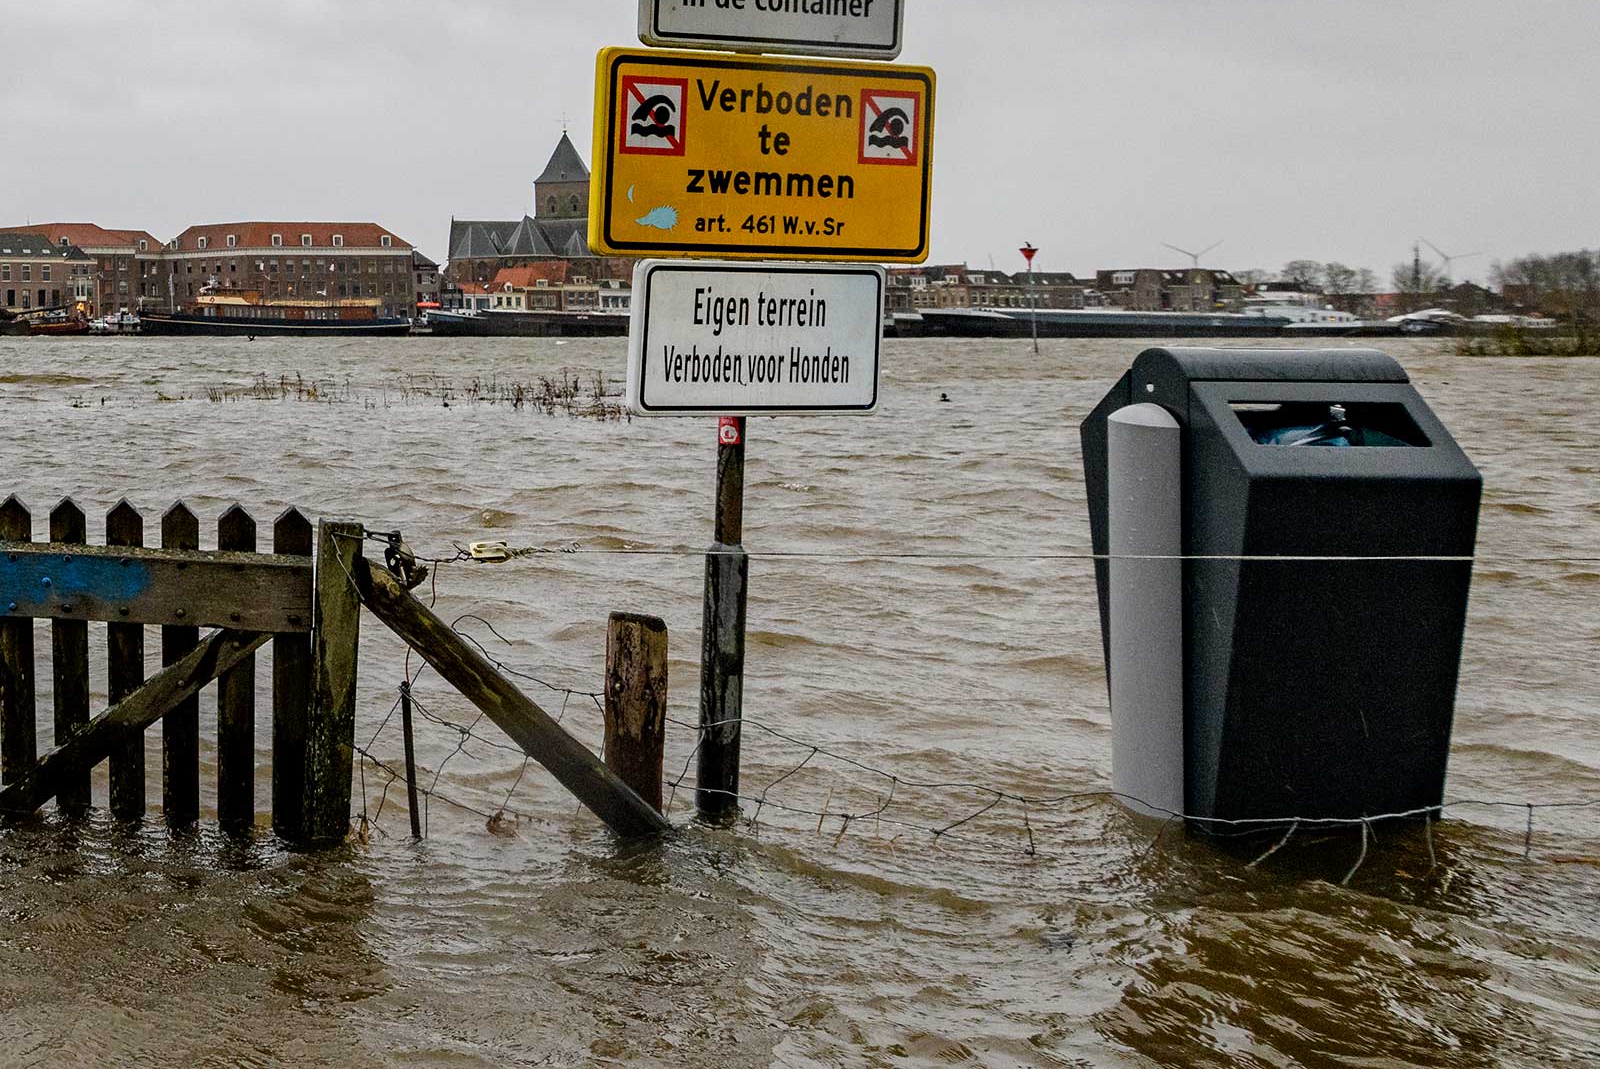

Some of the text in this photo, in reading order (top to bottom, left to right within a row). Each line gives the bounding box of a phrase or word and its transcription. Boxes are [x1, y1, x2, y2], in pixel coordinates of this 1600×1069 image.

[696, 79, 853, 118] Verboden
[758, 124, 791, 156] te
[686, 169, 854, 199] zwemmen
[695, 214, 845, 236] art. 461 W.v.Sr
[693, 286, 826, 336] Eigen terrein
[664, 345, 849, 383] Verboden voor Honden
